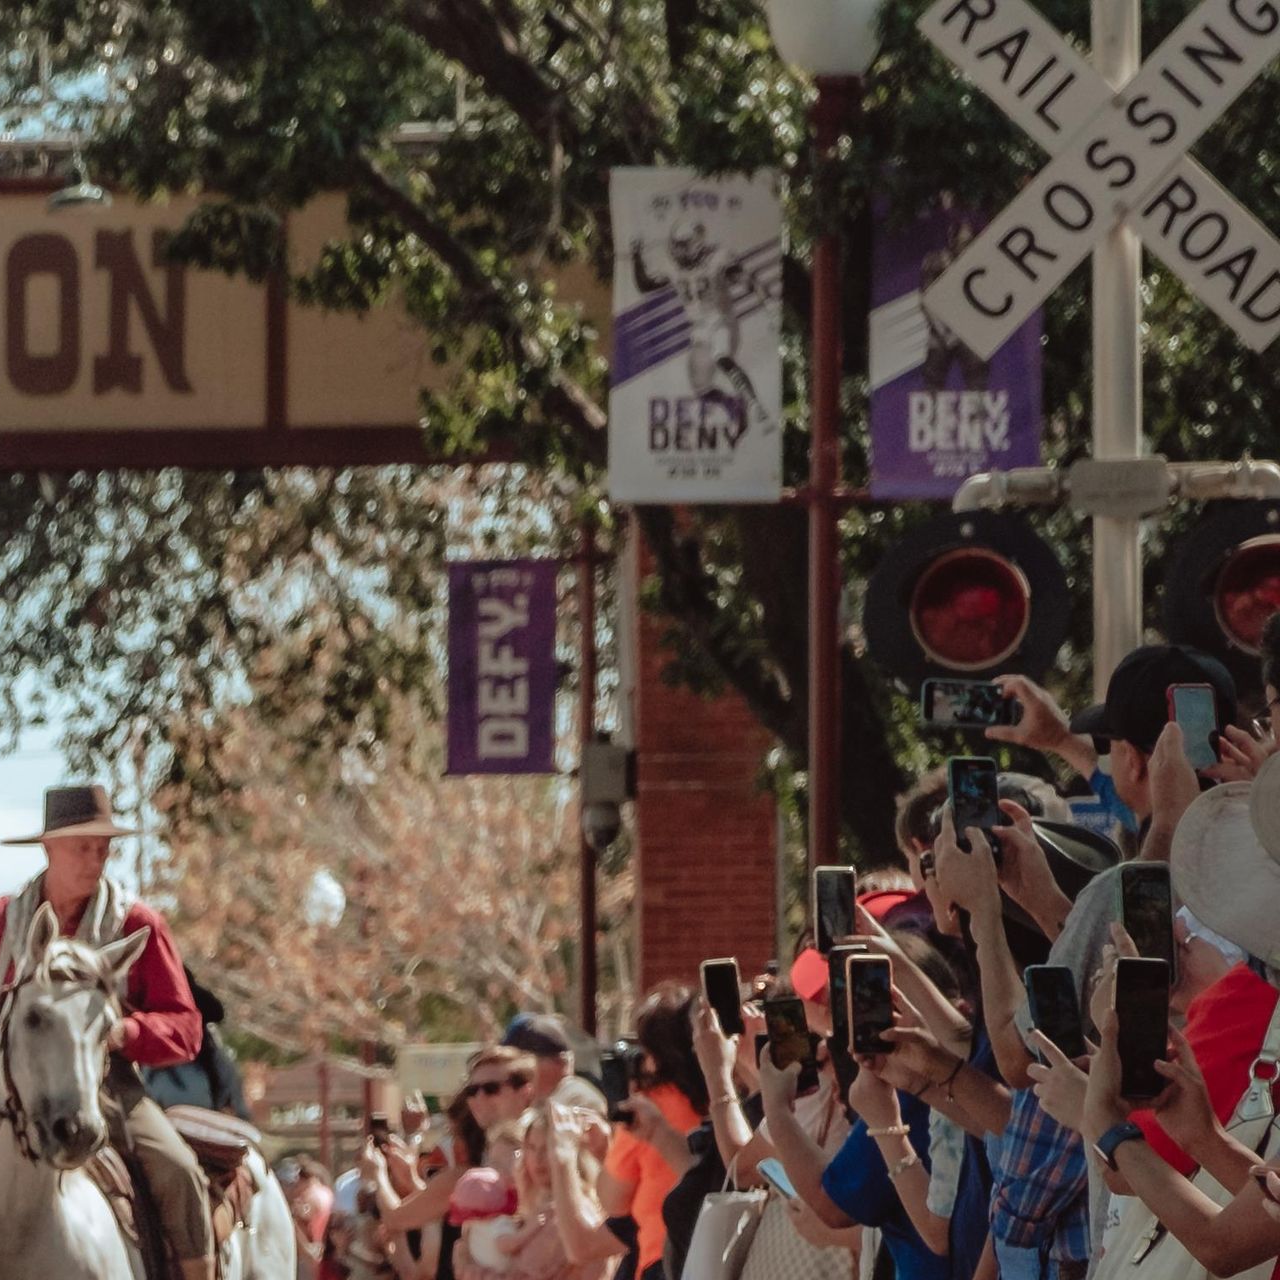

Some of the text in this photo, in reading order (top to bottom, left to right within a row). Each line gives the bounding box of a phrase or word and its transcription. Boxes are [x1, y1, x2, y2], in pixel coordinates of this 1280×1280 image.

[941, 0, 1280, 323] RAIL ROAD
[962, 0, 1280, 318] CROSSING
[477, 593, 531, 760] DEFY.
